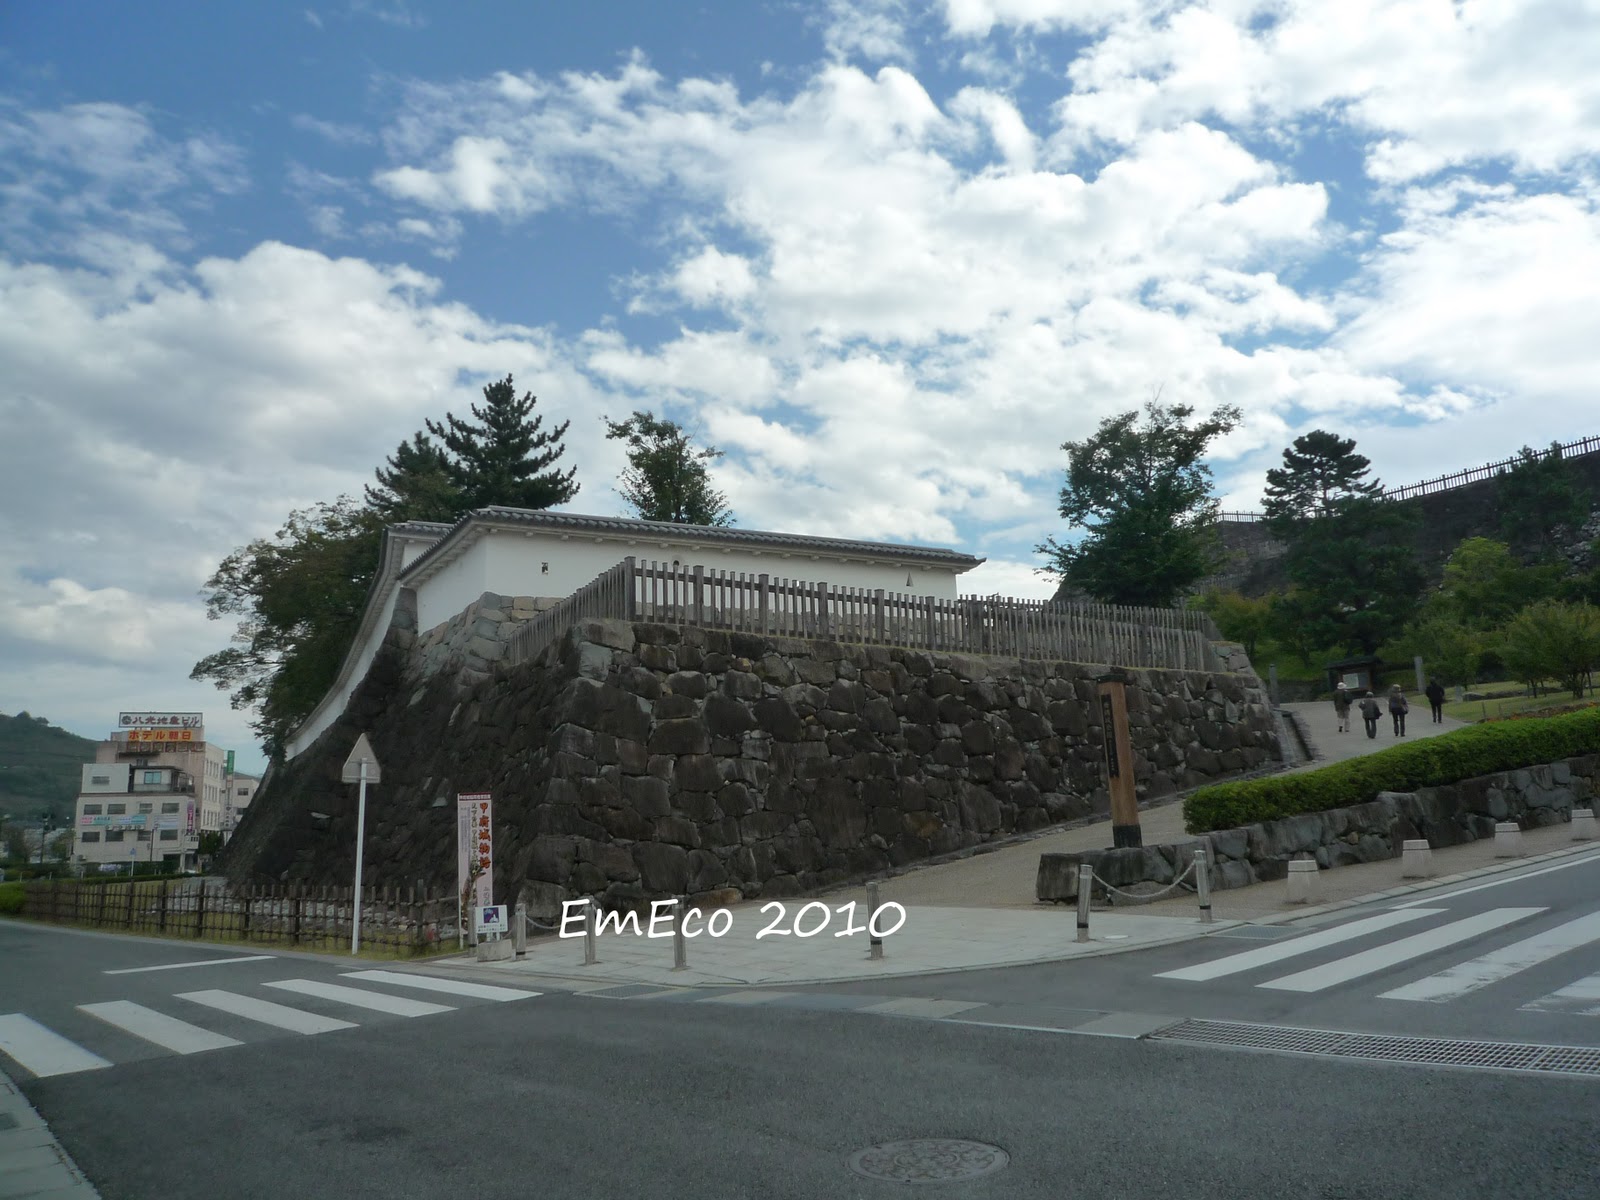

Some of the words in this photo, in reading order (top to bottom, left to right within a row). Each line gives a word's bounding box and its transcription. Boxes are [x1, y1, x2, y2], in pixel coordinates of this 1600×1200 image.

[128, 730, 192, 740] ホテル朝日
[478, 802, 491, 869] 甲府城物語
